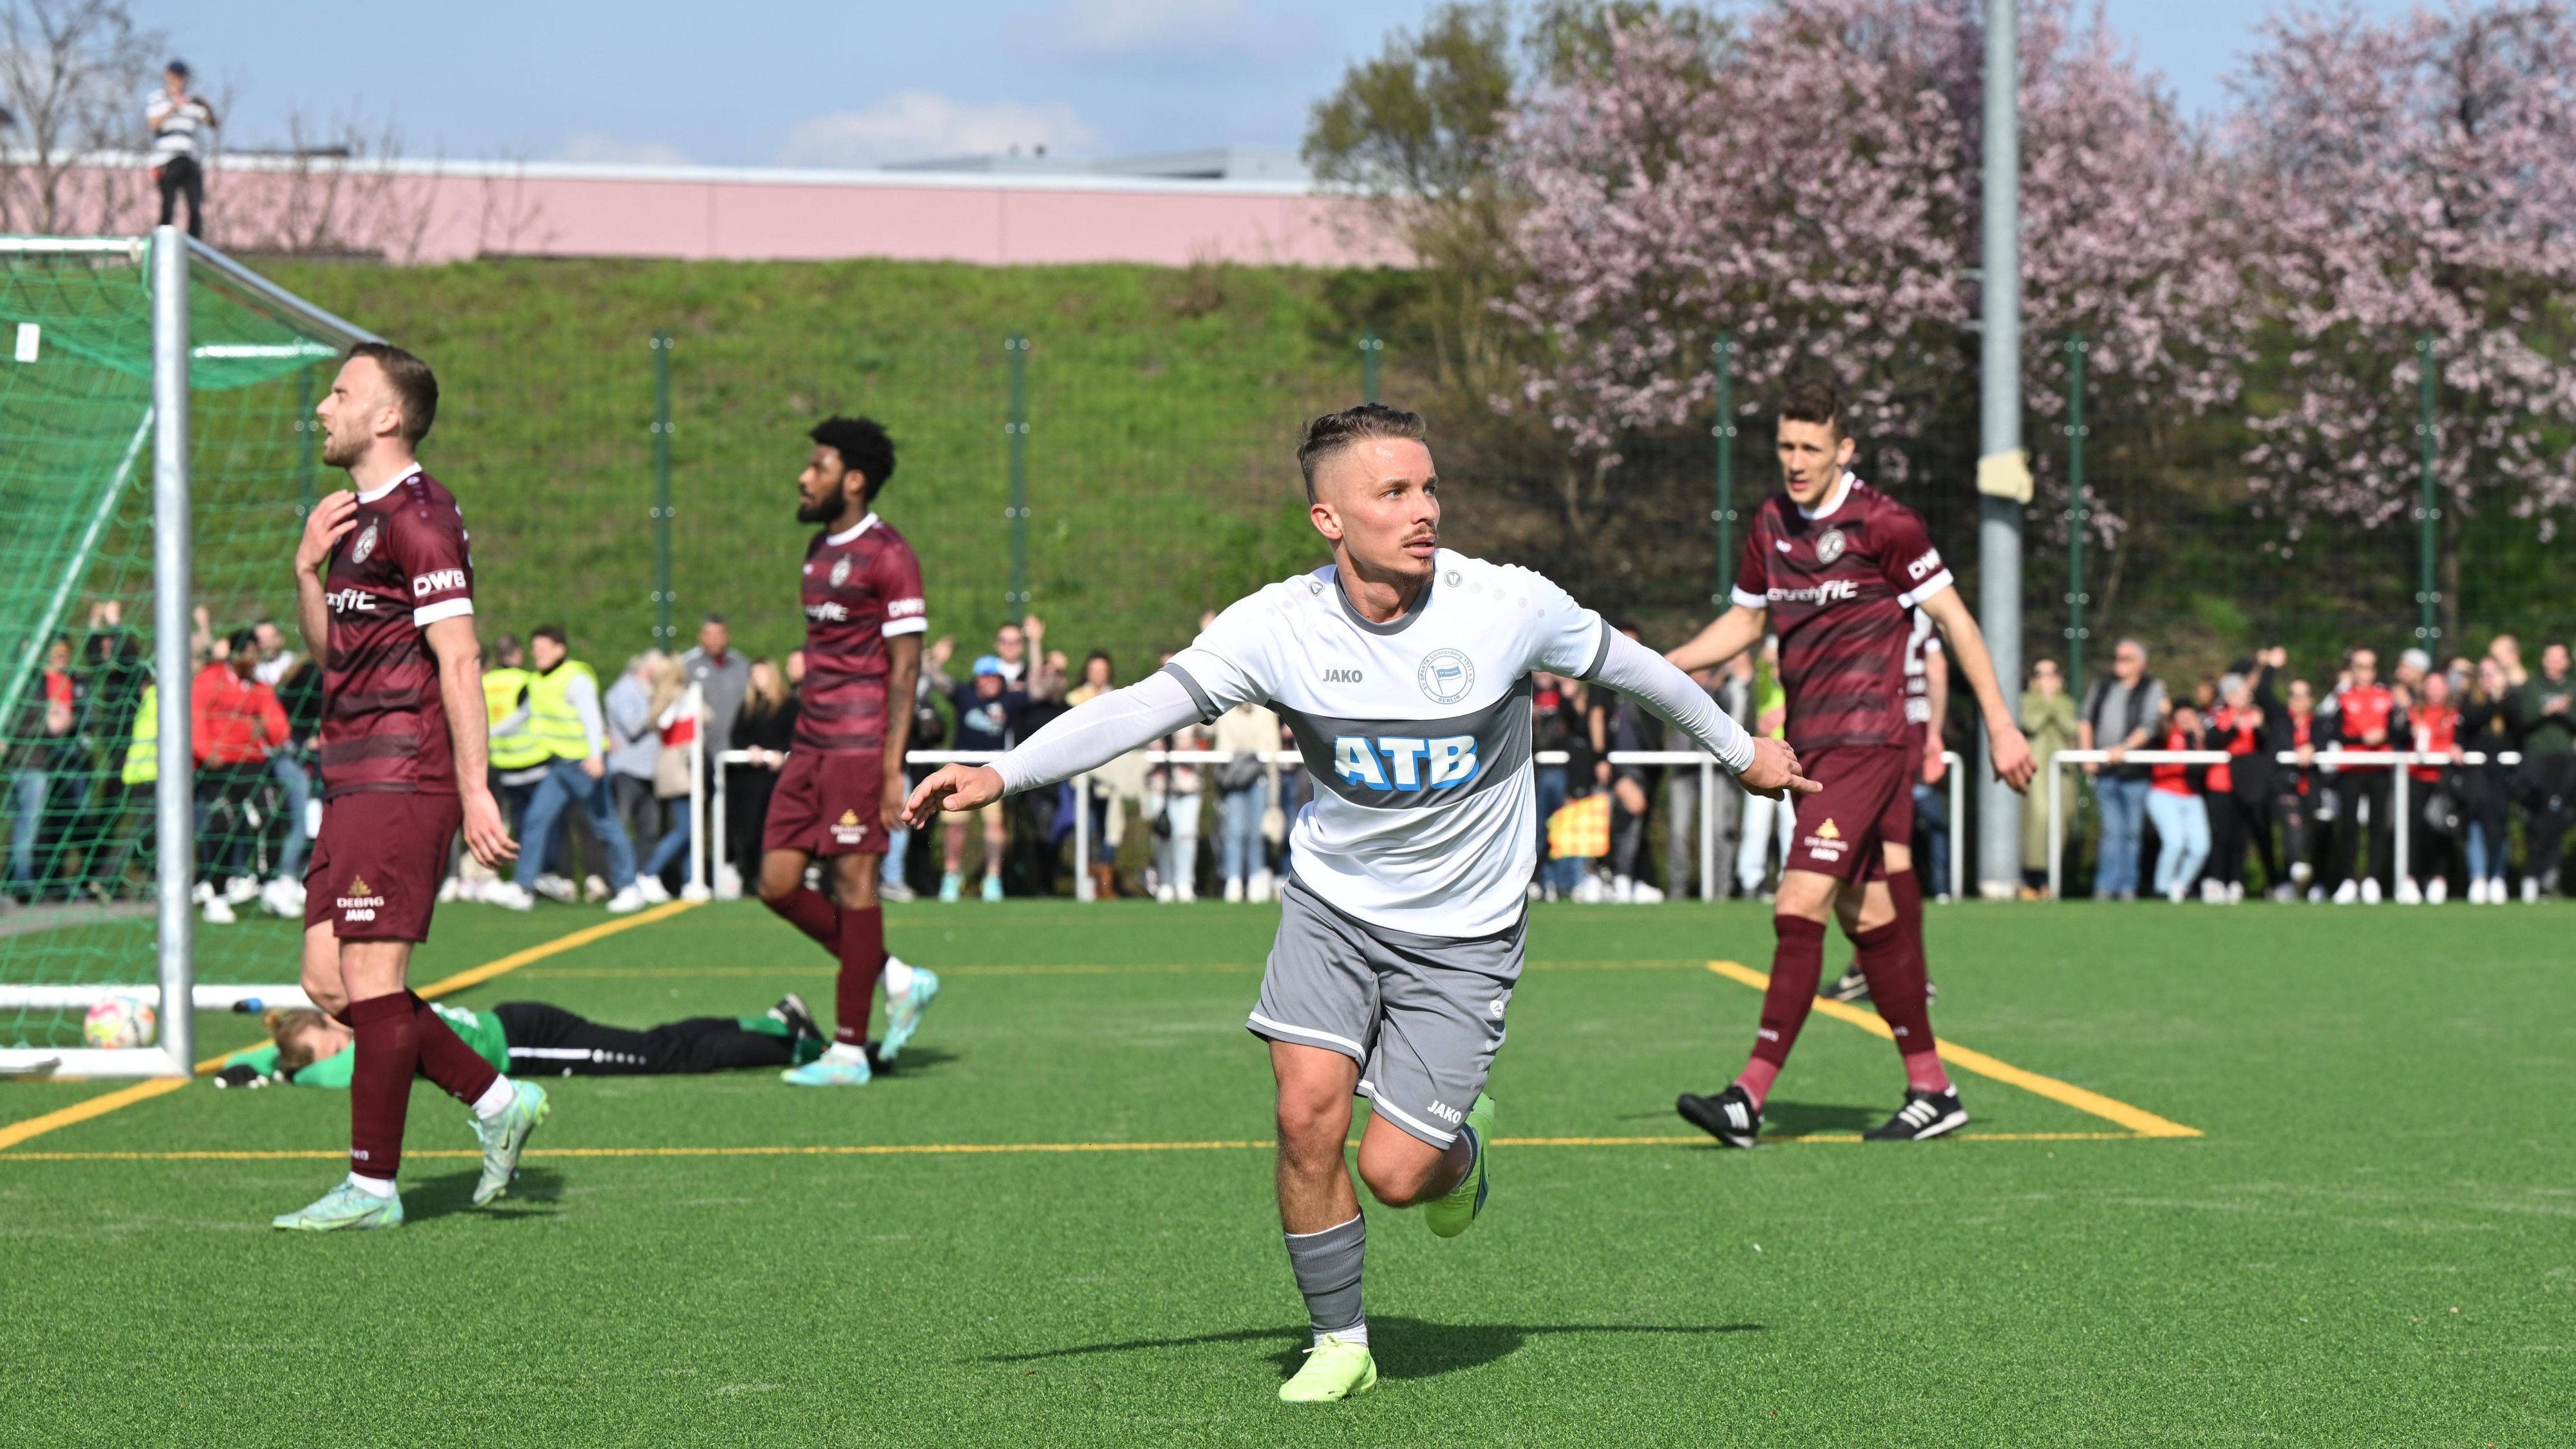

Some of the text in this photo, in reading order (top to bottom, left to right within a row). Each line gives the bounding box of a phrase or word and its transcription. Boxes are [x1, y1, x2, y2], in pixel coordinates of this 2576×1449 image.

[413, 570, 466, 598] DWB
[1323, 669, 1363, 683] JAKO
[1420, 659, 1430, 681] SPARTA
[1438, 695, 1461, 703] BERLIN
[1334, 735, 1479, 791] ATB
[1427, 1099, 1462, 1124] JAKO
